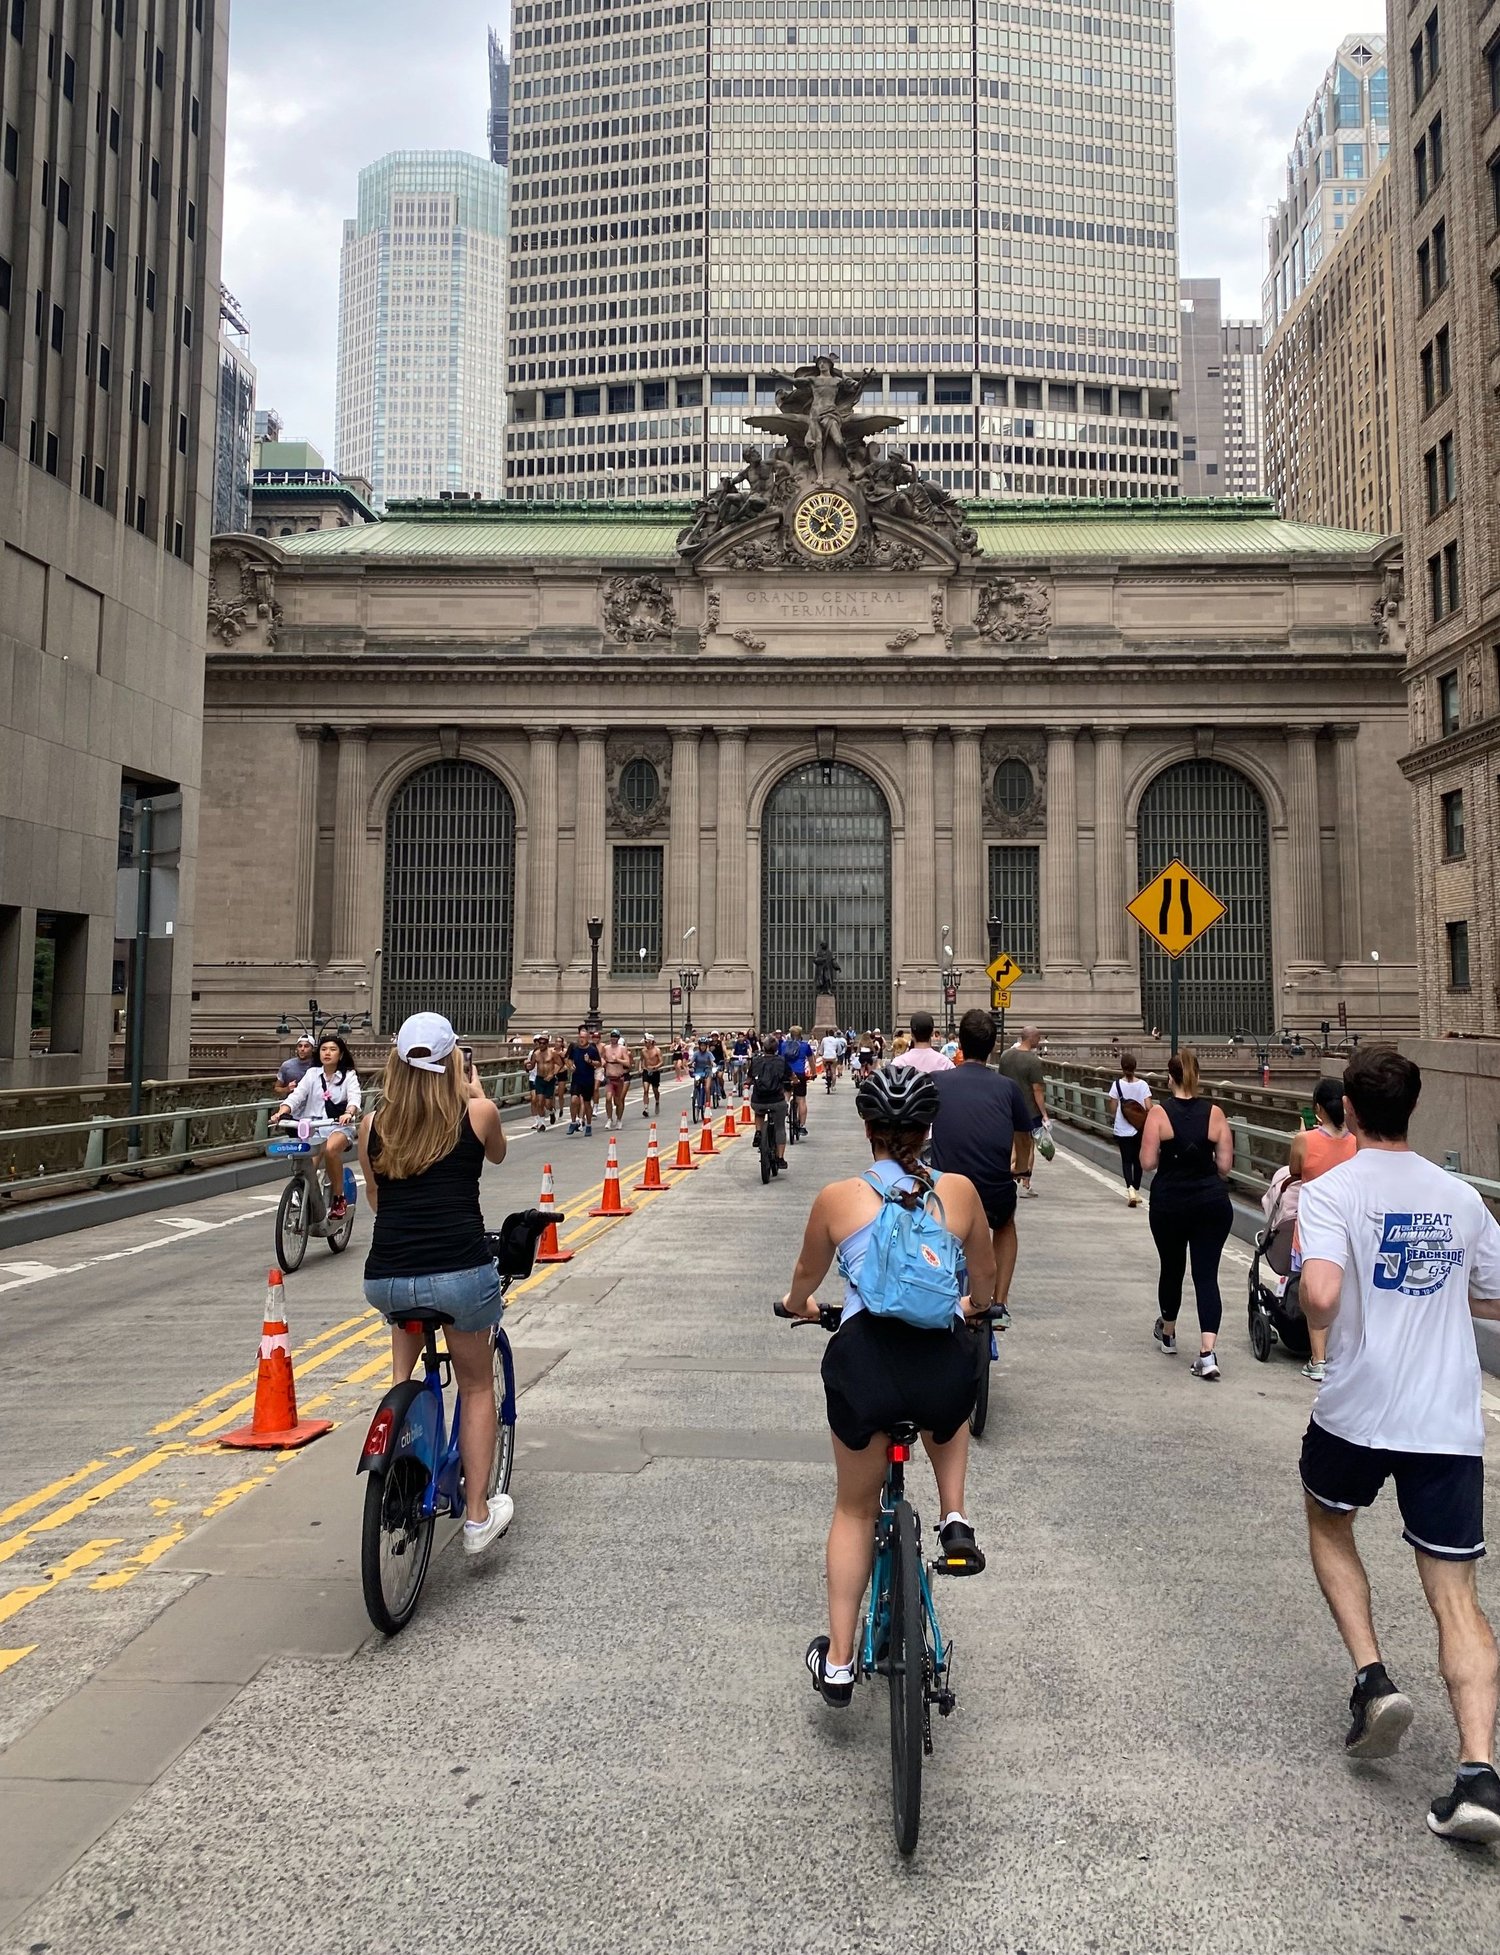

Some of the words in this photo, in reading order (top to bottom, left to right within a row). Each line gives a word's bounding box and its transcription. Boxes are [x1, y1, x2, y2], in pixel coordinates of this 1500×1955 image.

[746, 591, 809, 603] GRAND
[822, 591, 905, 603] CENTRAL
[781, 605, 871, 617] TERMINAL
[998, 992, 1008, 1001] 15
[1386, 1225, 1453, 1246] Champions
[1373, 1213, 1413, 1290] 5
[1413, 1213, 1453, 1226] PEAT
[1407, 1248, 1463, 1264] BEACHSIDE
